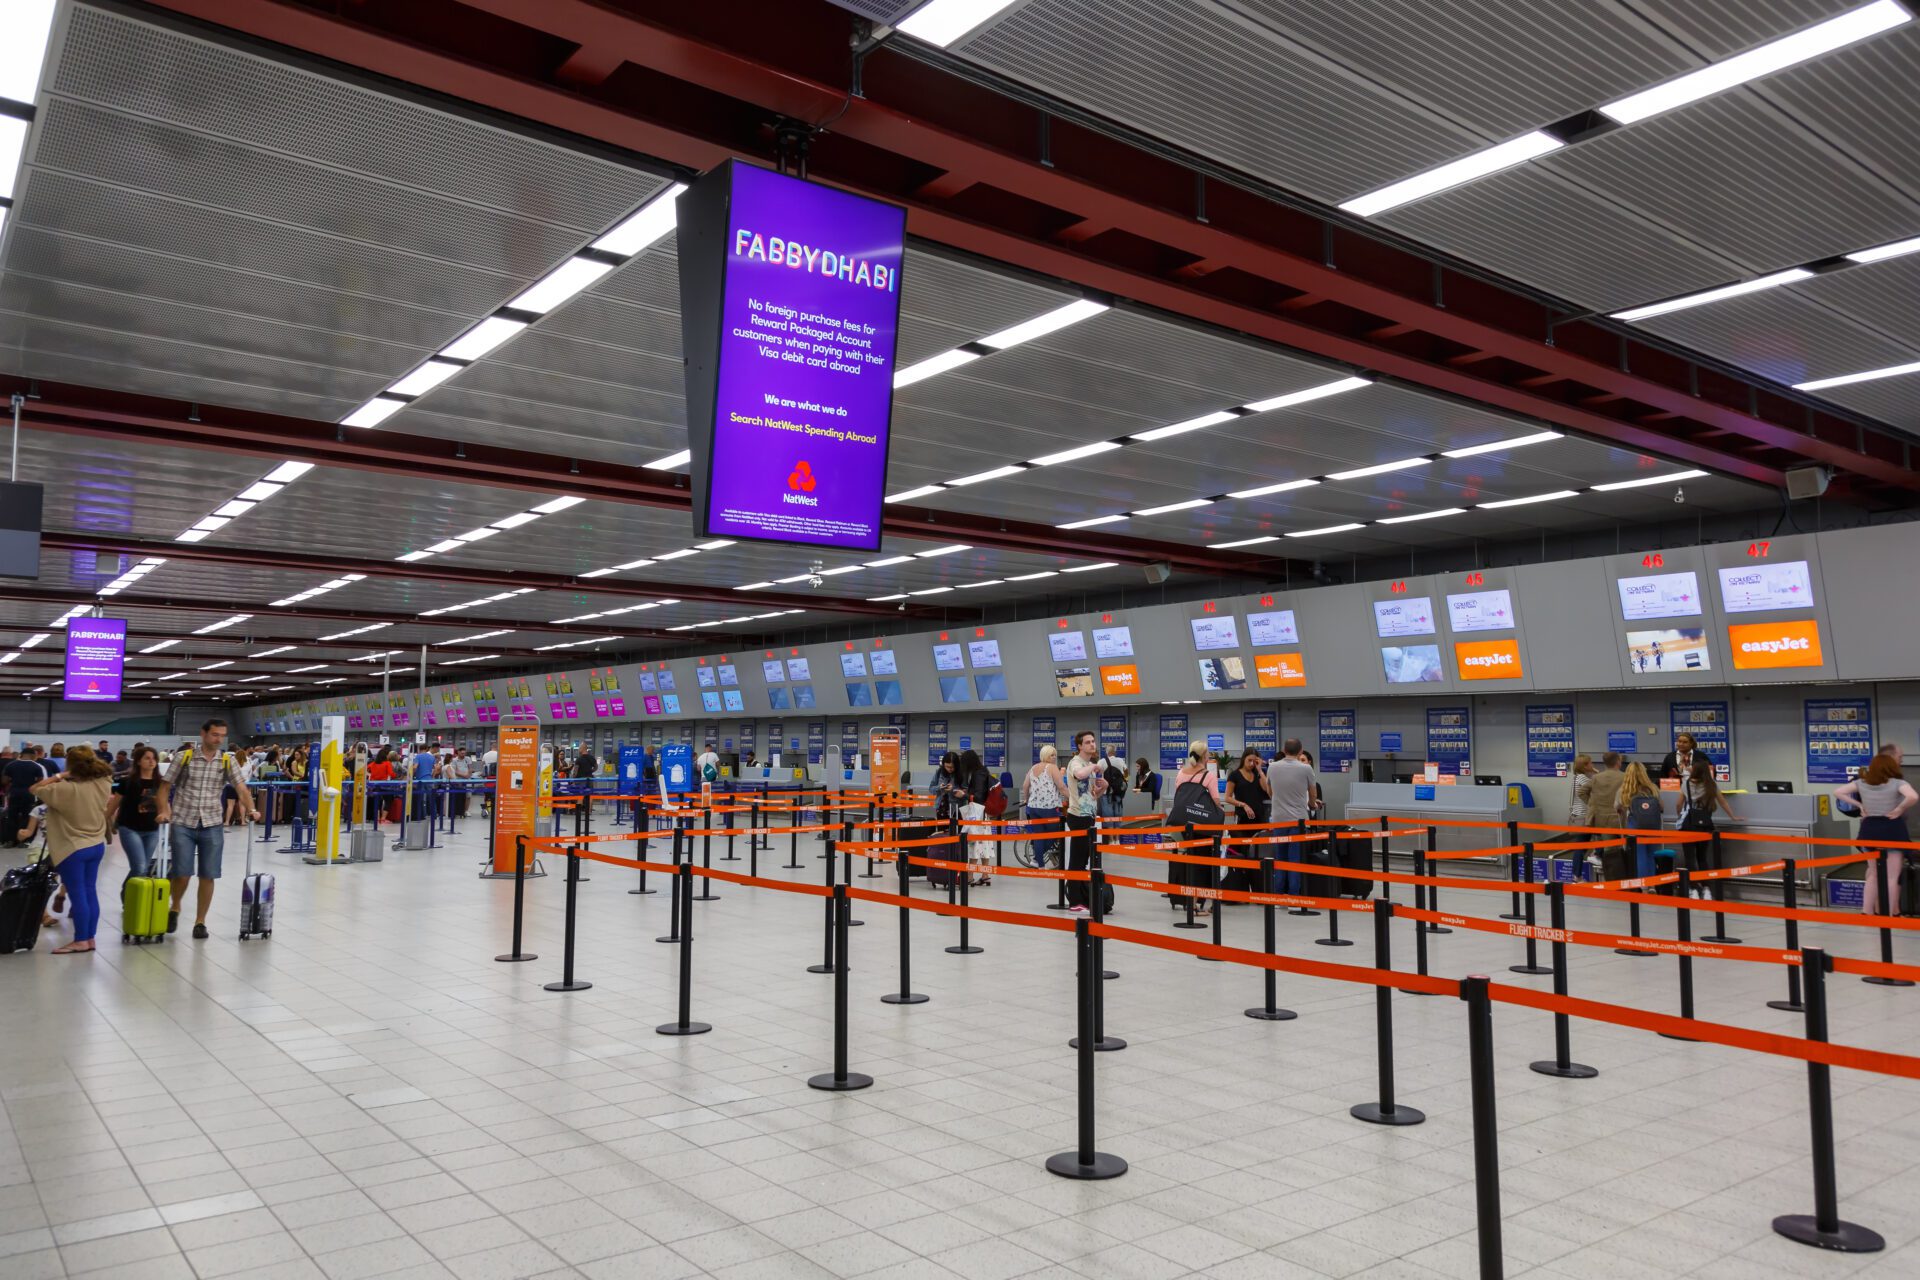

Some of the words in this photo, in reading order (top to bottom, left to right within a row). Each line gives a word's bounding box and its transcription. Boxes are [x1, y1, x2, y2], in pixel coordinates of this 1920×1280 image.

[735, 228, 895, 292] FABBYDHABI
[748, 298, 763, 311] No
[765, 301, 798, 319] foreign
[800, 311, 841, 328] purchase
[843, 319, 861, 333] fees
[863, 323, 876, 336] for
[751, 313, 787, 331] Reward
[789, 321, 834, 341] Packaged
[835, 332, 872, 349] Account
[732, 326, 783, 345] customers
[784, 336, 811, 350] when
[812, 343, 843, 360] paying
[844, 349, 864, 361] with
[865, 352, 885, 366] their
[758, 345, 779, 359] Visa
[781, 350, 804, 364] debit
[806, 356, 827, 369] card
[829, 359, 861, 375] abroad
[764, 393, 780, 406] We
[781, 398, 796, 408] are
[798, 400, 821, 413] what
[822, 405, 835, 414] we
[836, 406, 848, 417] do
[730, 411, 763, 427] Search
[764, 417, 803, 433] NatWest
[804, 423, 845, 442] Spending
[845, 430, 876, 444] Abroad
[783, 493, 818, 506] NatWest
[1747, 541, 1771, 558] 47
[1641, 554, 1664, 568] 46
[1465, 572, 1484, 587] 45
[1391, 581, 1407, 593] 44
[70, 630, 125, 641] FABBYDHABI
[1741, 636, 1810, 655] easyJet
[1464, 653, 1513, 667] easyJet
[1107, 672, 1133, 682] easyJet
[504, 737, 533, 745] easyJet
[1180, 886, 1196, 896] FLIGHT
[1196, 887, 1217, 899] TRACKER
[1351, 902, 1374, 910] easyJet
[1440, 916, 1466, 925] easyJet
[1509, 923, 1532, 936] FLIGHT
[1533, 925, 1565, 941] TRACKER
[1782, 953, 1803, 963] easy
